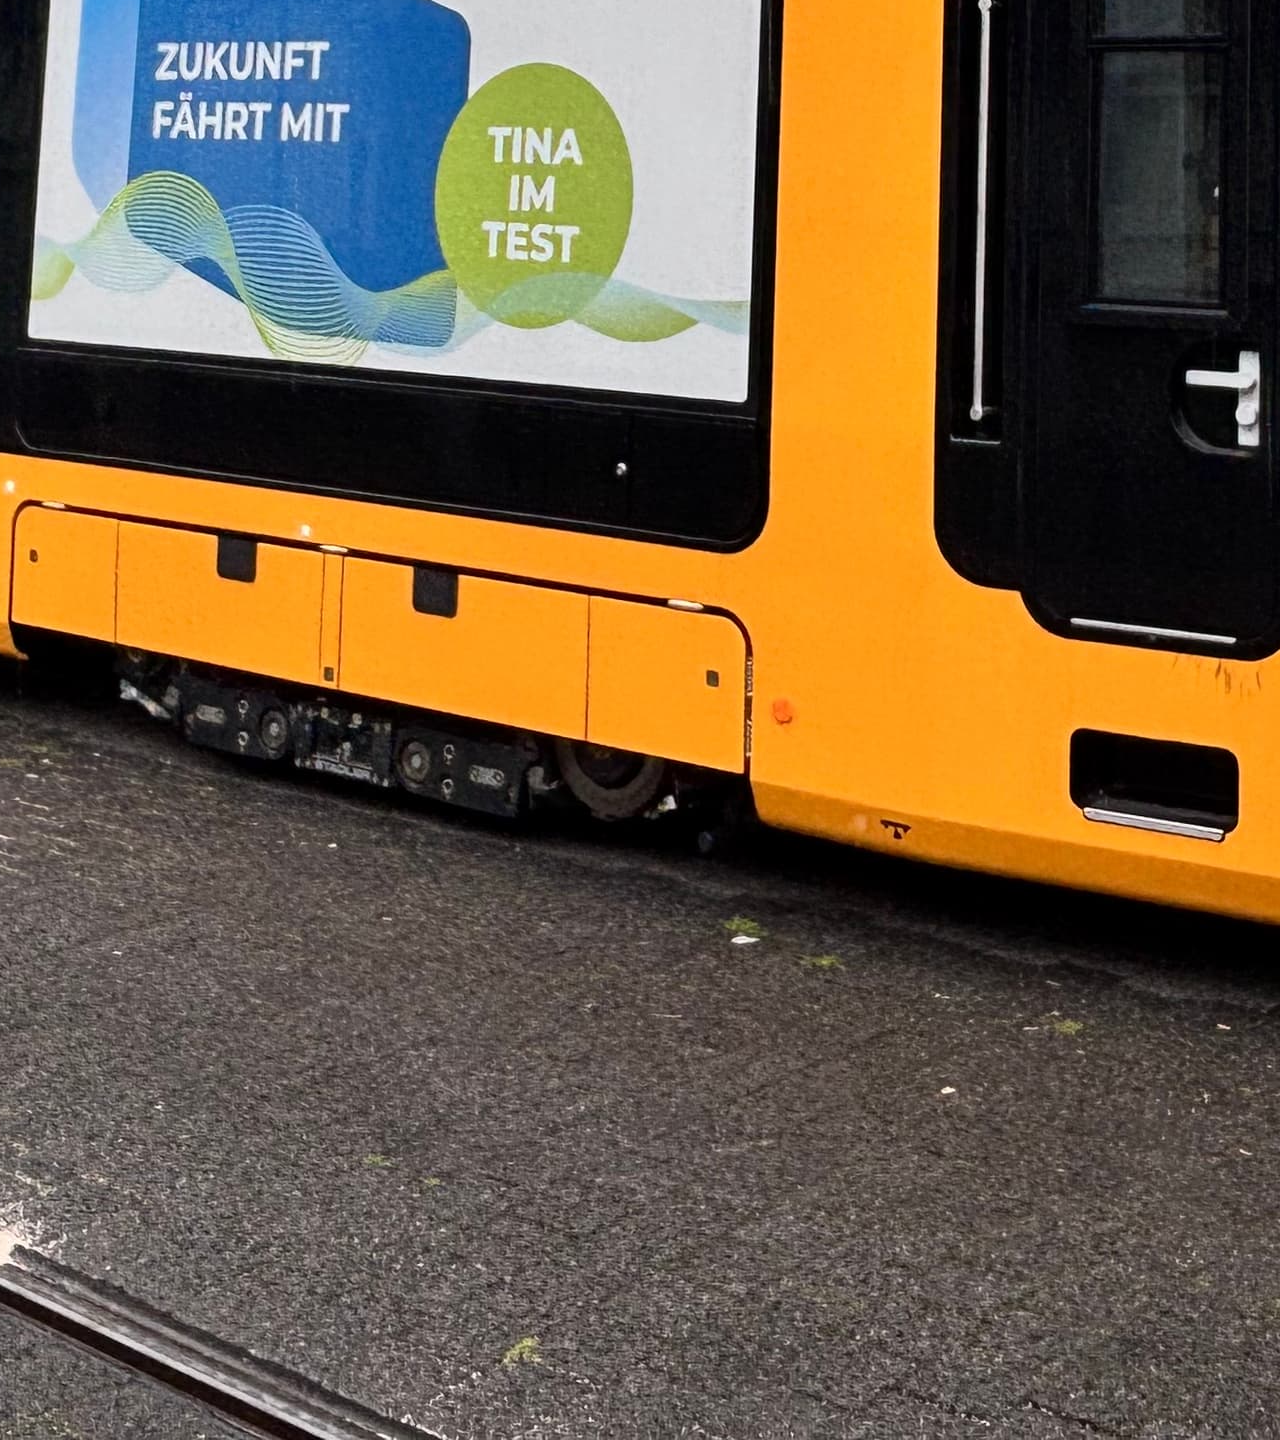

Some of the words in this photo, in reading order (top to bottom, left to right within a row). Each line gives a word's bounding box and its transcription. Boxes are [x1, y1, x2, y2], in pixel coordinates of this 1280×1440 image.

[155, 41, 330, 81] ZUKUNFT
[152, 91, 272, 140] FÄHRT
[280, 102, 350, 142] MIT
[487, 126, 584, 166] TINA
[509, 175, 556, 213] IM
[481, 220, 581, 263] TEST
